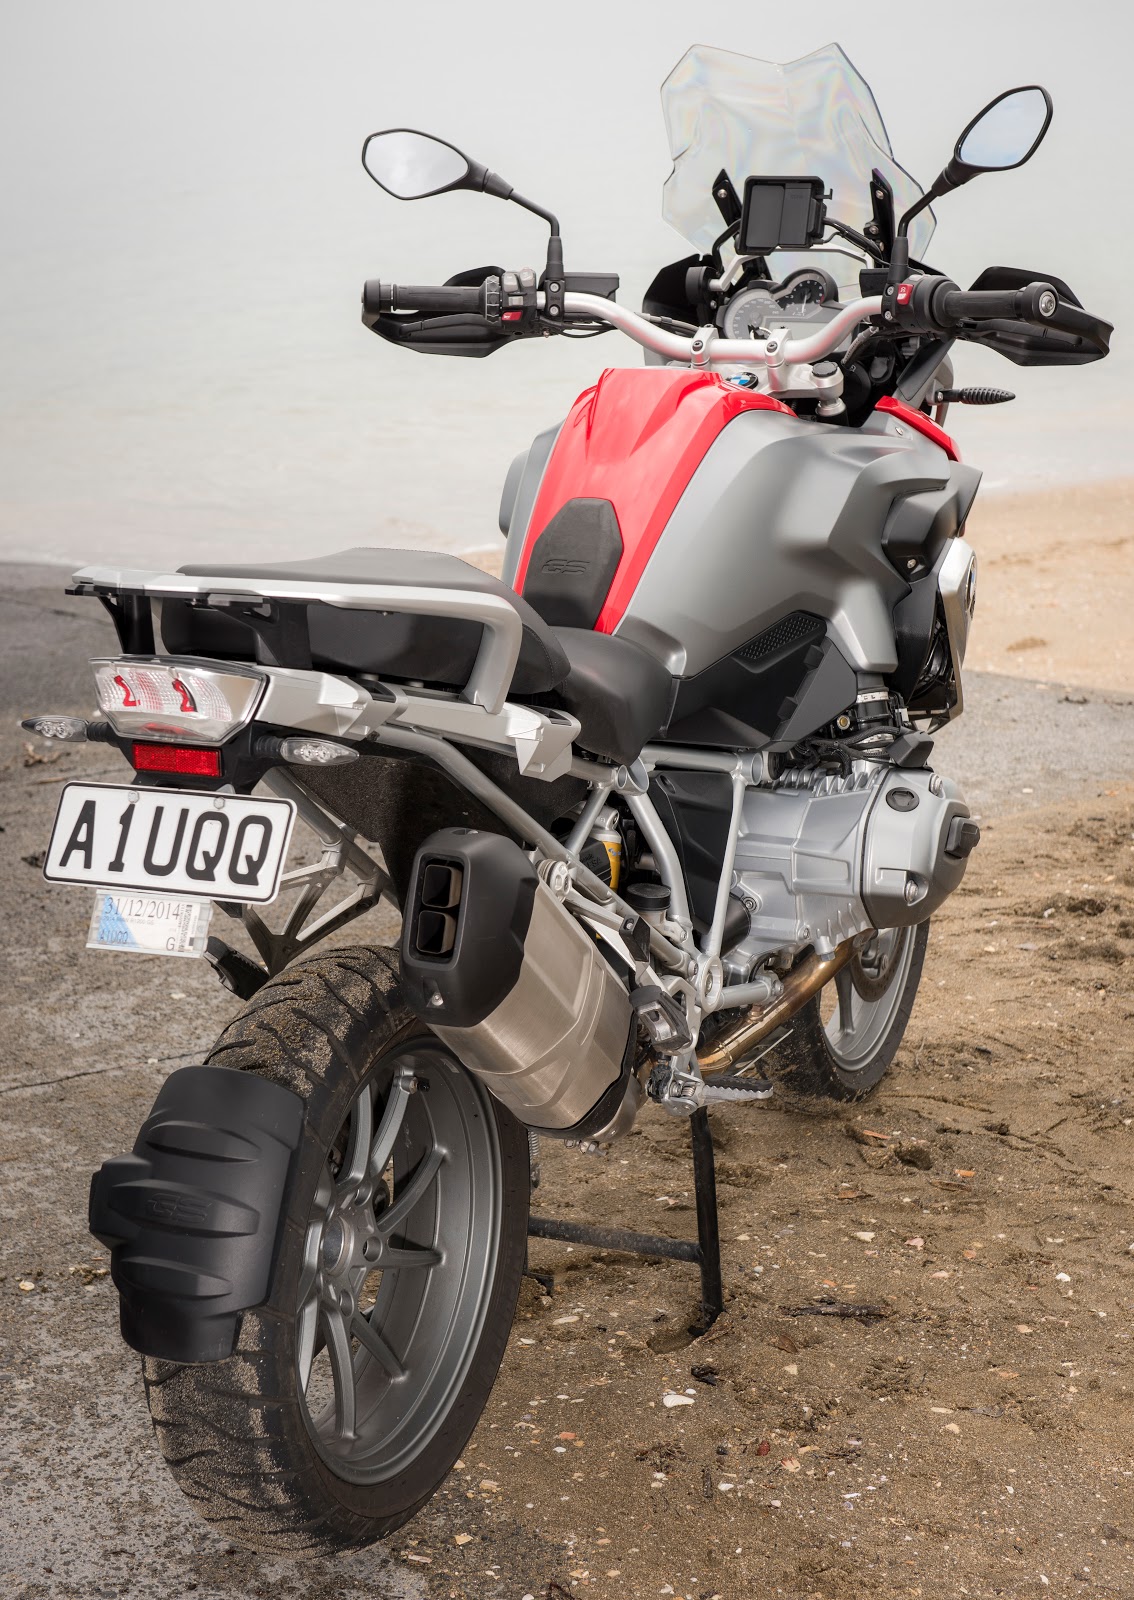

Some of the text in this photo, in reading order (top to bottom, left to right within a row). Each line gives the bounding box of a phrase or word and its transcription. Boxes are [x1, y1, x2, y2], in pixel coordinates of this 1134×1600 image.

[541, 558, 590, 575] GS
[58, 799, 274, 887] A1UQQ
[104, 896, 180, 921] 31/12/2014
[165, 936, 176, 952] G
[147, 1192, 213, 1224] GS
